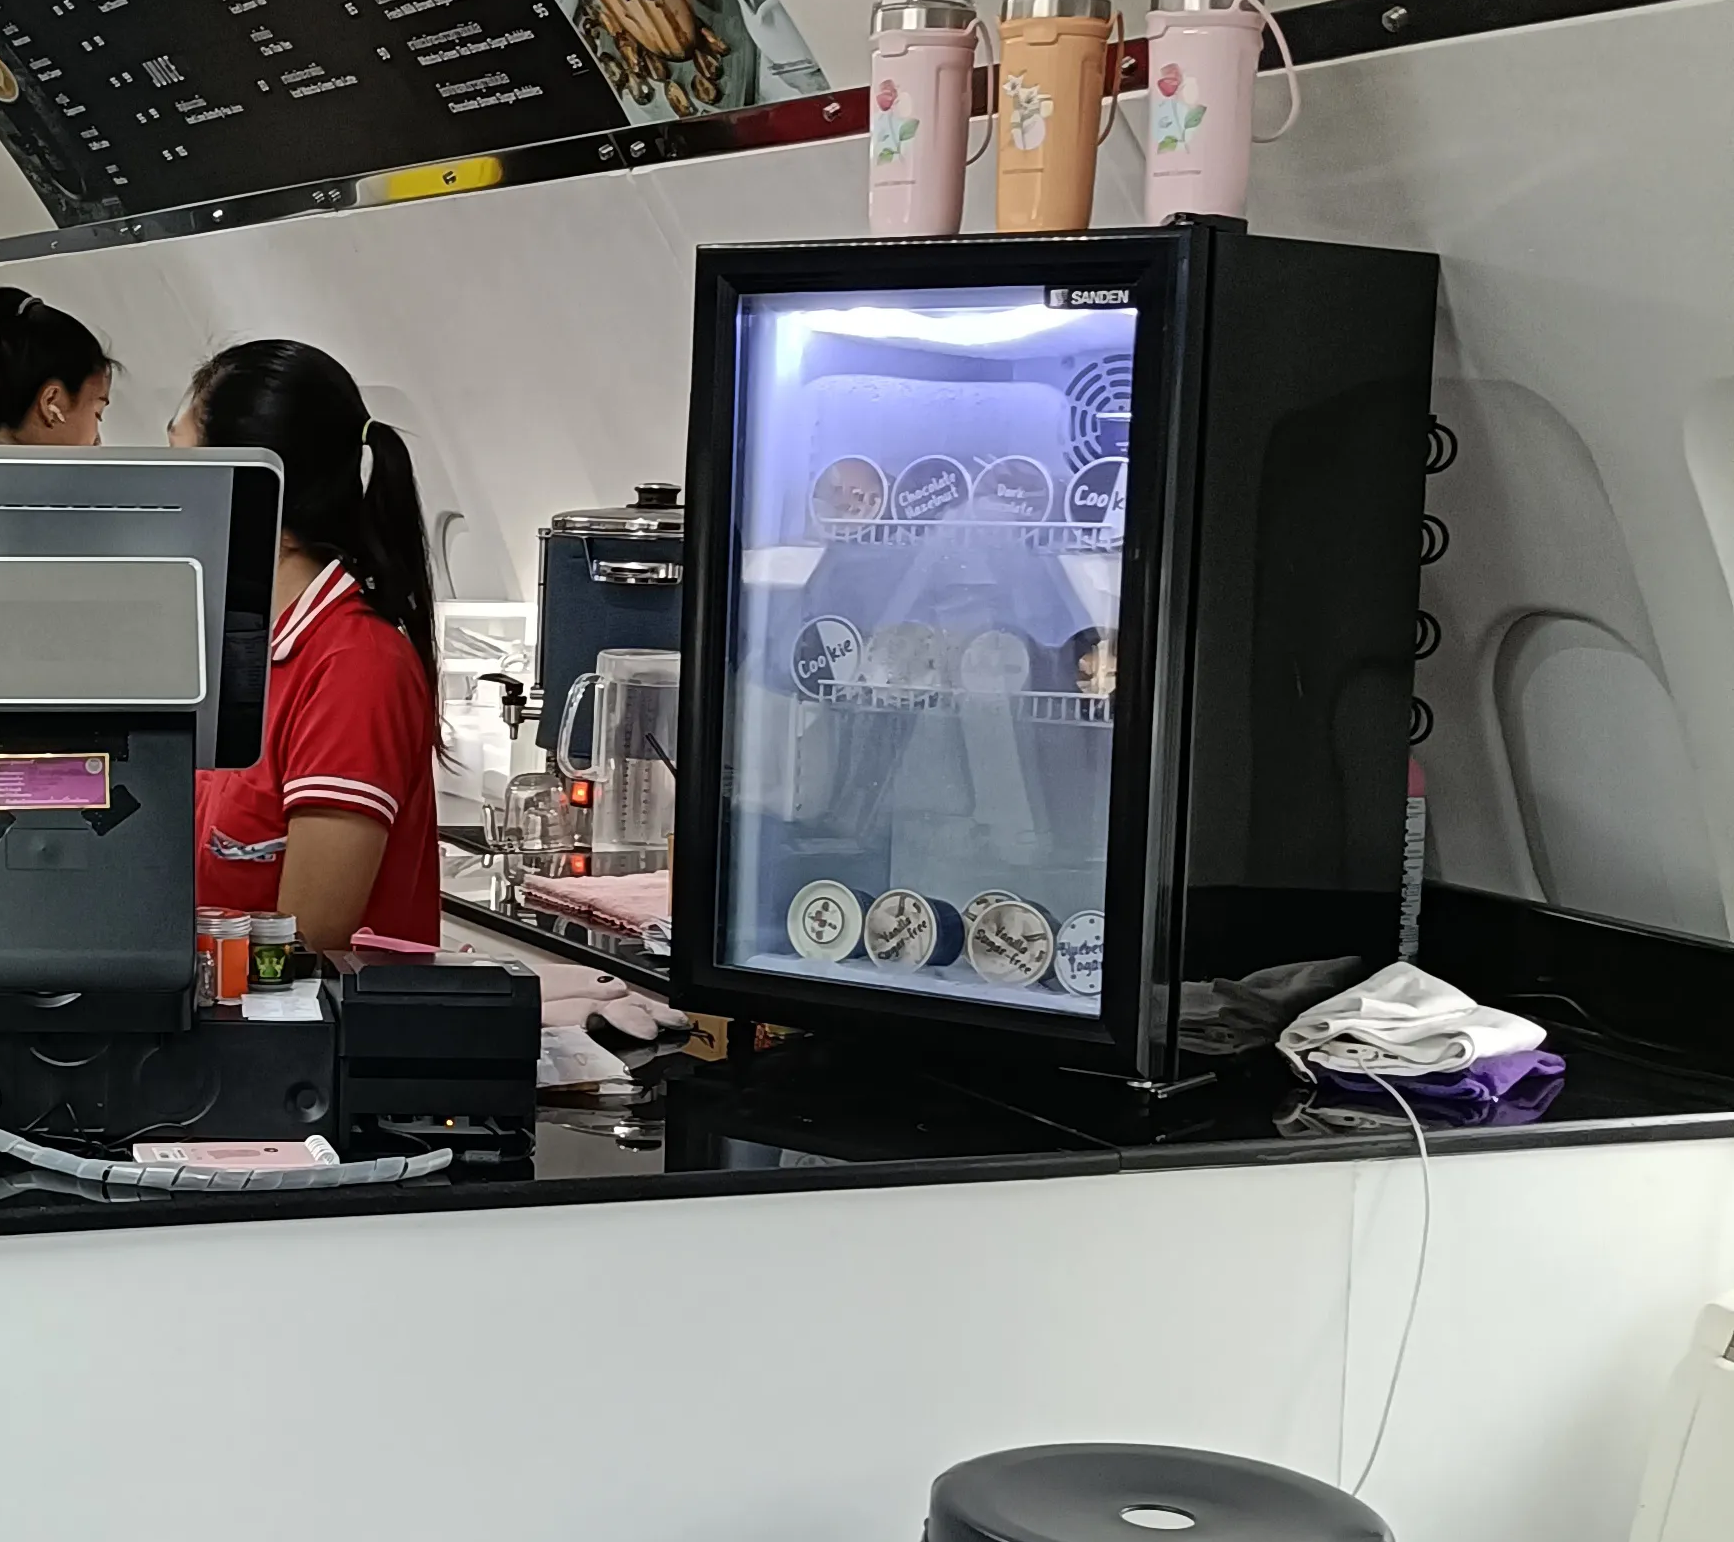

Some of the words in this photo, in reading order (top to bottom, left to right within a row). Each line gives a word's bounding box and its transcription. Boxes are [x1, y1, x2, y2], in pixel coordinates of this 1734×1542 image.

[142, 56, 184, 87] JUICE
[1071, 290, 1129, 305] SANDEN
[899, 471, 956, 506] Chocolate
[905, 484, 958, 519] Hazelnut
[1074, 485, 1125, 511] Cook
[798, 640, 853, 678] Cookie
[975, 929, 1032, 974] Sugar-free
[995, 926, 1028, 954] Vanilla
[1058, 941, 1103, 956] Blueber
